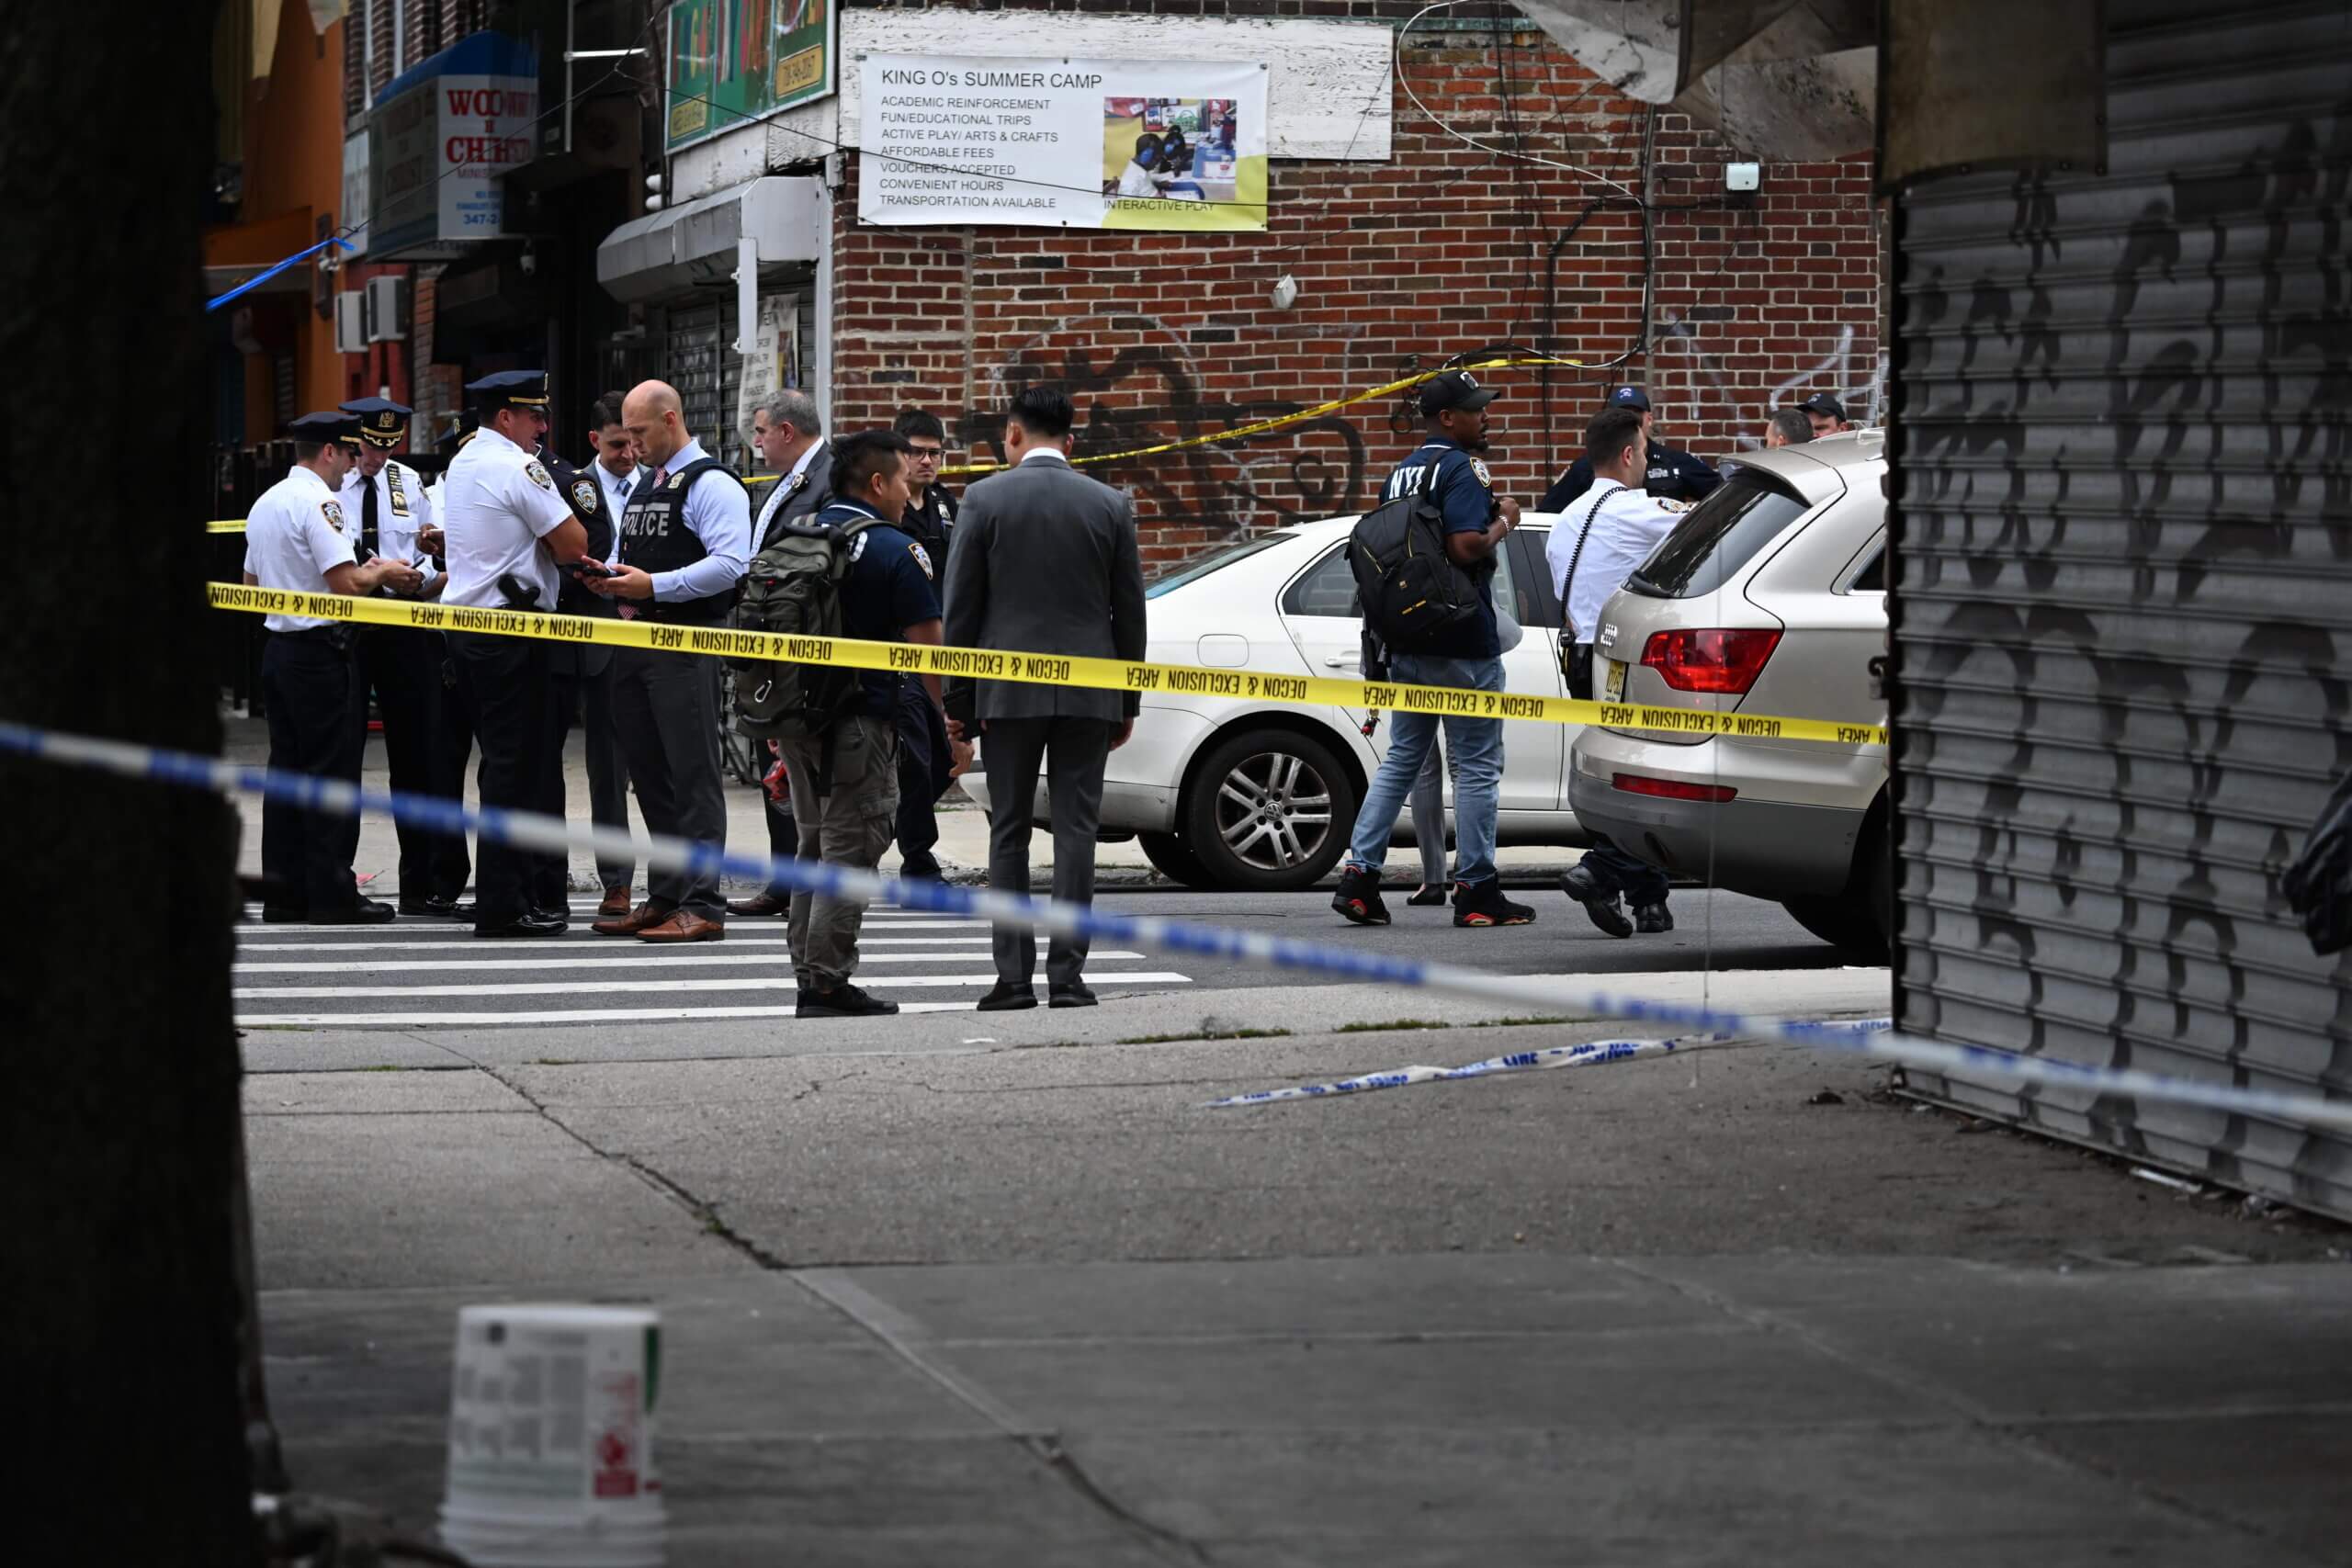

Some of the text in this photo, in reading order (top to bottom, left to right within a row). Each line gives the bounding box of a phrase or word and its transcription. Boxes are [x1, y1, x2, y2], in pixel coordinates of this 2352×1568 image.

[882, 70, 1102, 88] KING O's SUMMER CAMP
[881, 96, 1051, 109] ACADEMIC REINFORCEMENT
[881, 112, 1031, 126] FUN/EDUCATIONAL TRIPS
[882, 129, 1058, 142] ACTIVE PLAY/ ARTS & CRAFTS
[881, 146, 994, 158] AFFORDABLE FEES
[880, 162, 1015, 175] VOUCHERS ACCEPTED
[880, 178, 1003, 191] CONVENIENT HOURS
[880, 195, 1057, 208] TRANSPORTATION AVAILABLE
[1104, 199, 1214, 211] INTERACTIVE PLAY
[463, 214, 500, 224] 347-2
[622, 513, 670, 536] POLICE
[211, 587, 353, 617] DECON & EXCLUSION
[533, 617, 544, 634] &
[650, 626, 831, 660] DECON & EXCLUSION AREA
[889, 647, 1069, 681] DECON & EXCLUSION AREA
[1126, 667, 1306, 699] DECON & EXCLUSION AREA
[1363, 685, 1544, 717] DECON & EXCLUSION AREA
[1600, 705, 1781, 738] DECON & EXCLUSION AREA
[1838, 727, 1871, 744] AREA
